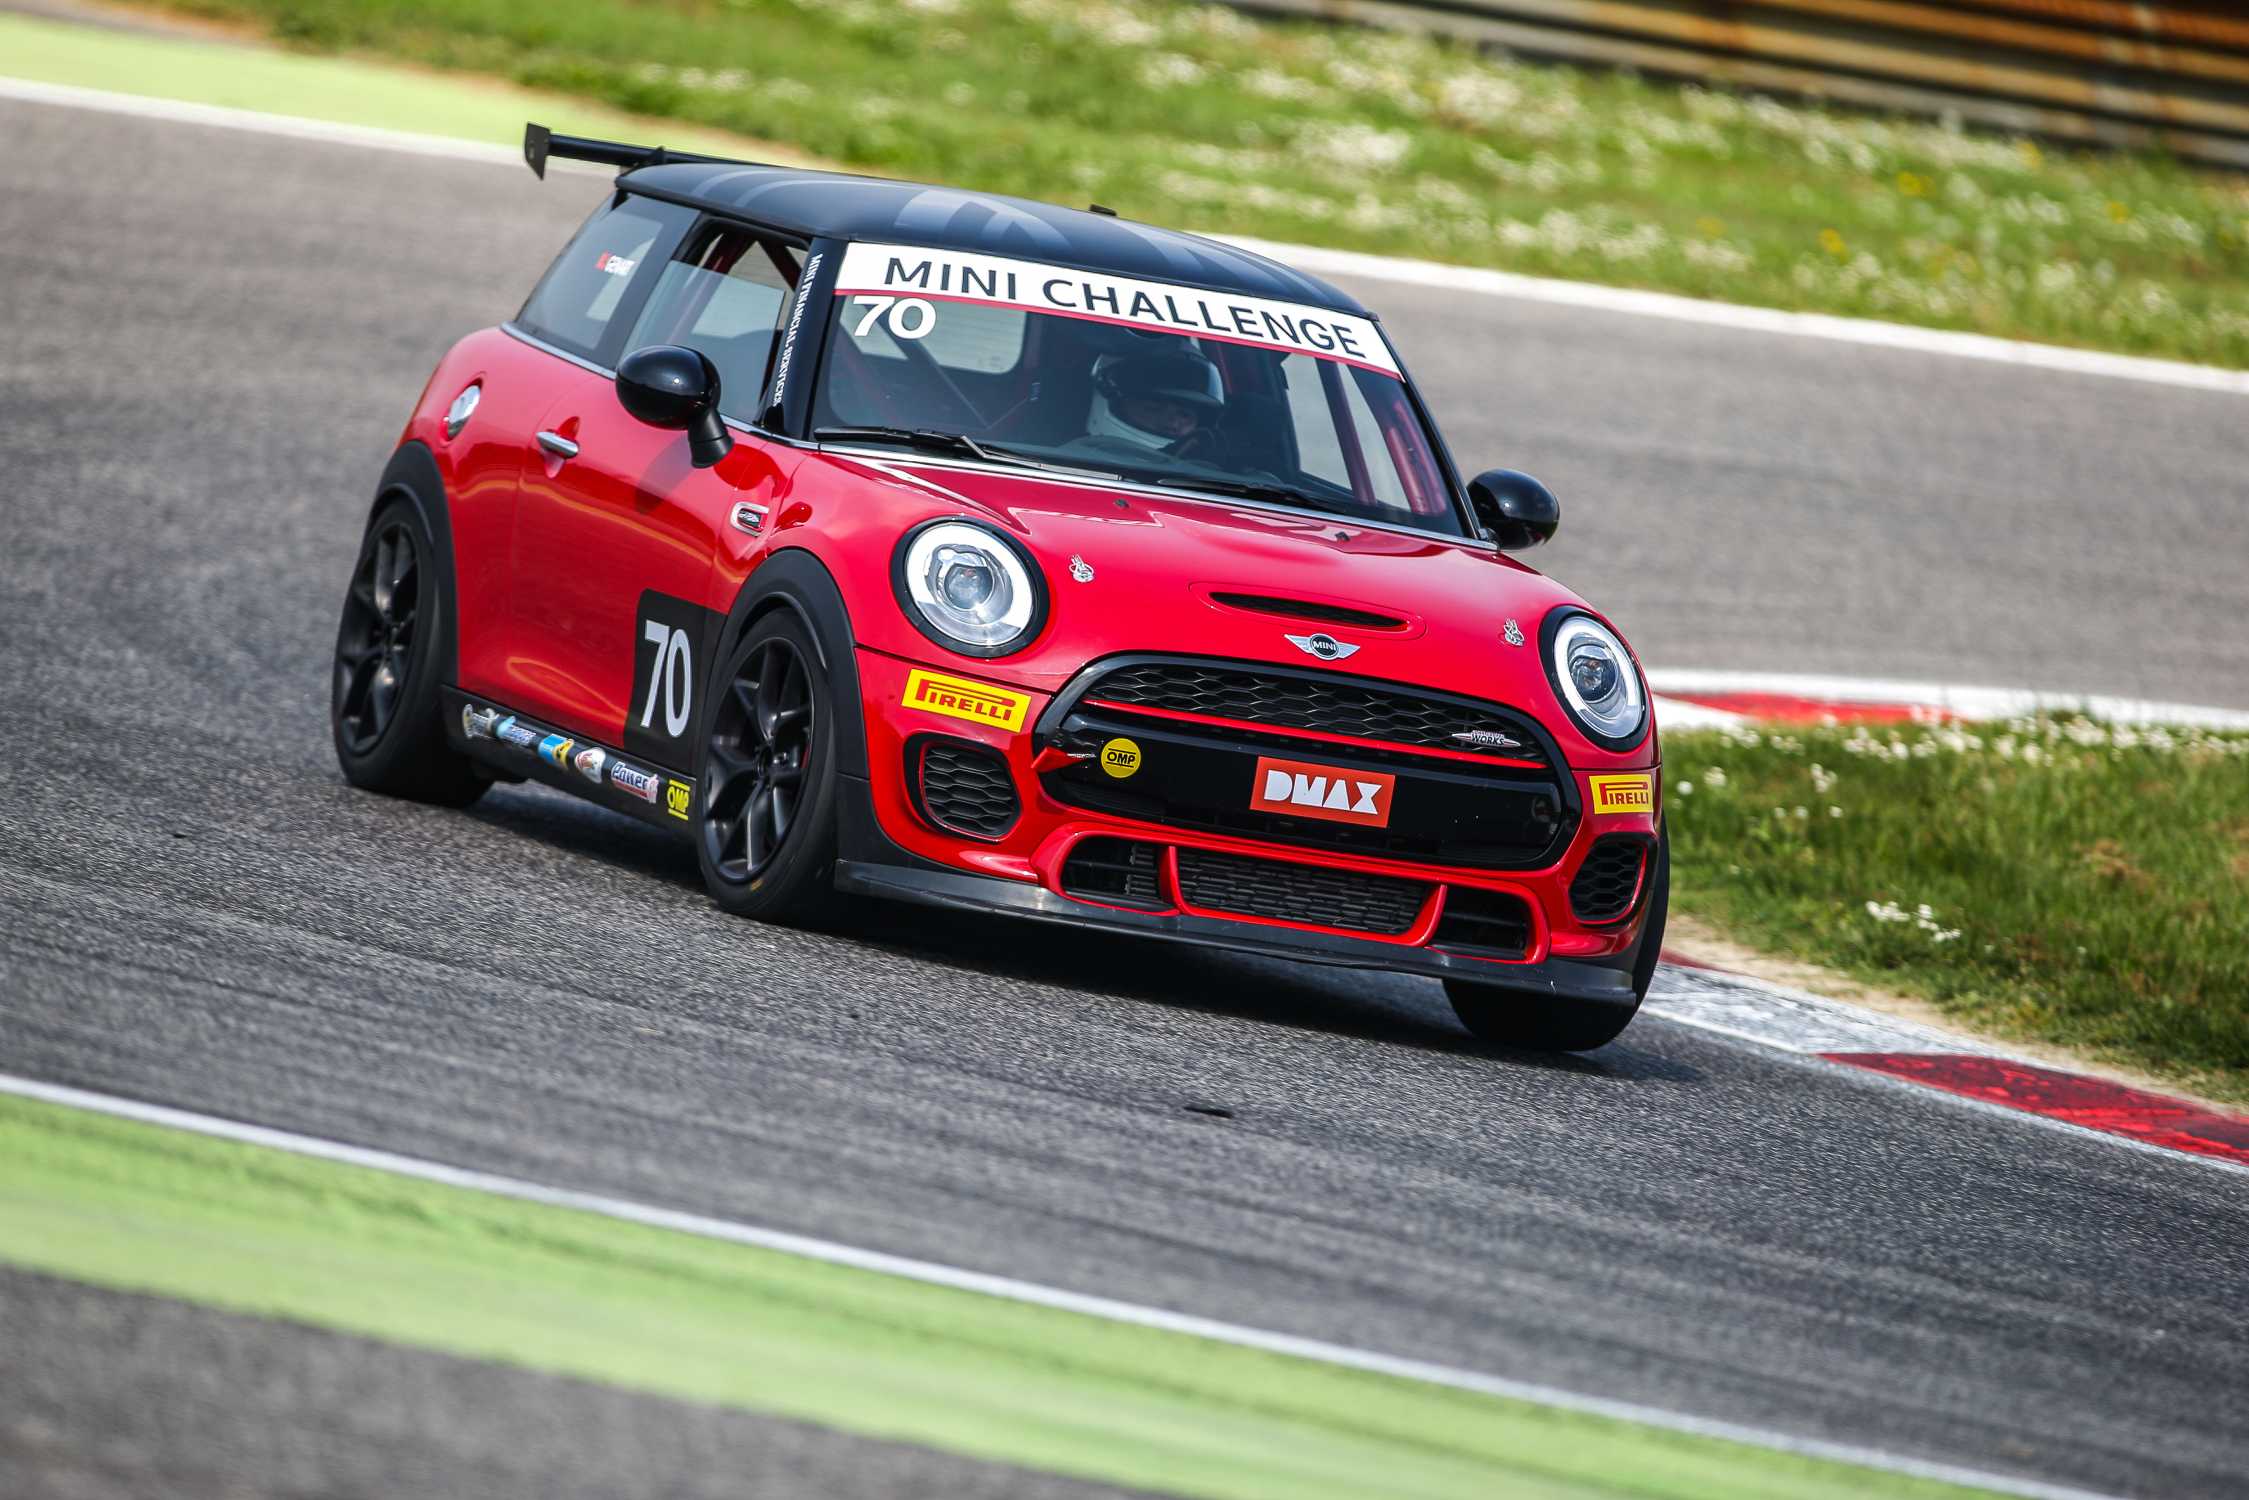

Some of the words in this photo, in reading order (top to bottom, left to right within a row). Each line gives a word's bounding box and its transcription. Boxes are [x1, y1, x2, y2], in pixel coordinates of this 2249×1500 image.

[853, 296, 936, 340] 70
[884, 257, 1016, 300] MINI
[1042, 279, 1366, 358] CHALLENGE
[1312, 640, 1337, 651] MINI
[640, 619, 692, 738] 70
[915, 678, 1017, 721] PIRELLI
[1471, 735, 1504, 745] WORKS
[1107, 751, 1136, 765] OMP
[667, 786, 689, 813] OMP
[1263, 769, 1383, 815] DMAX
[1599, 782, 1648, 805] PIRELLI
